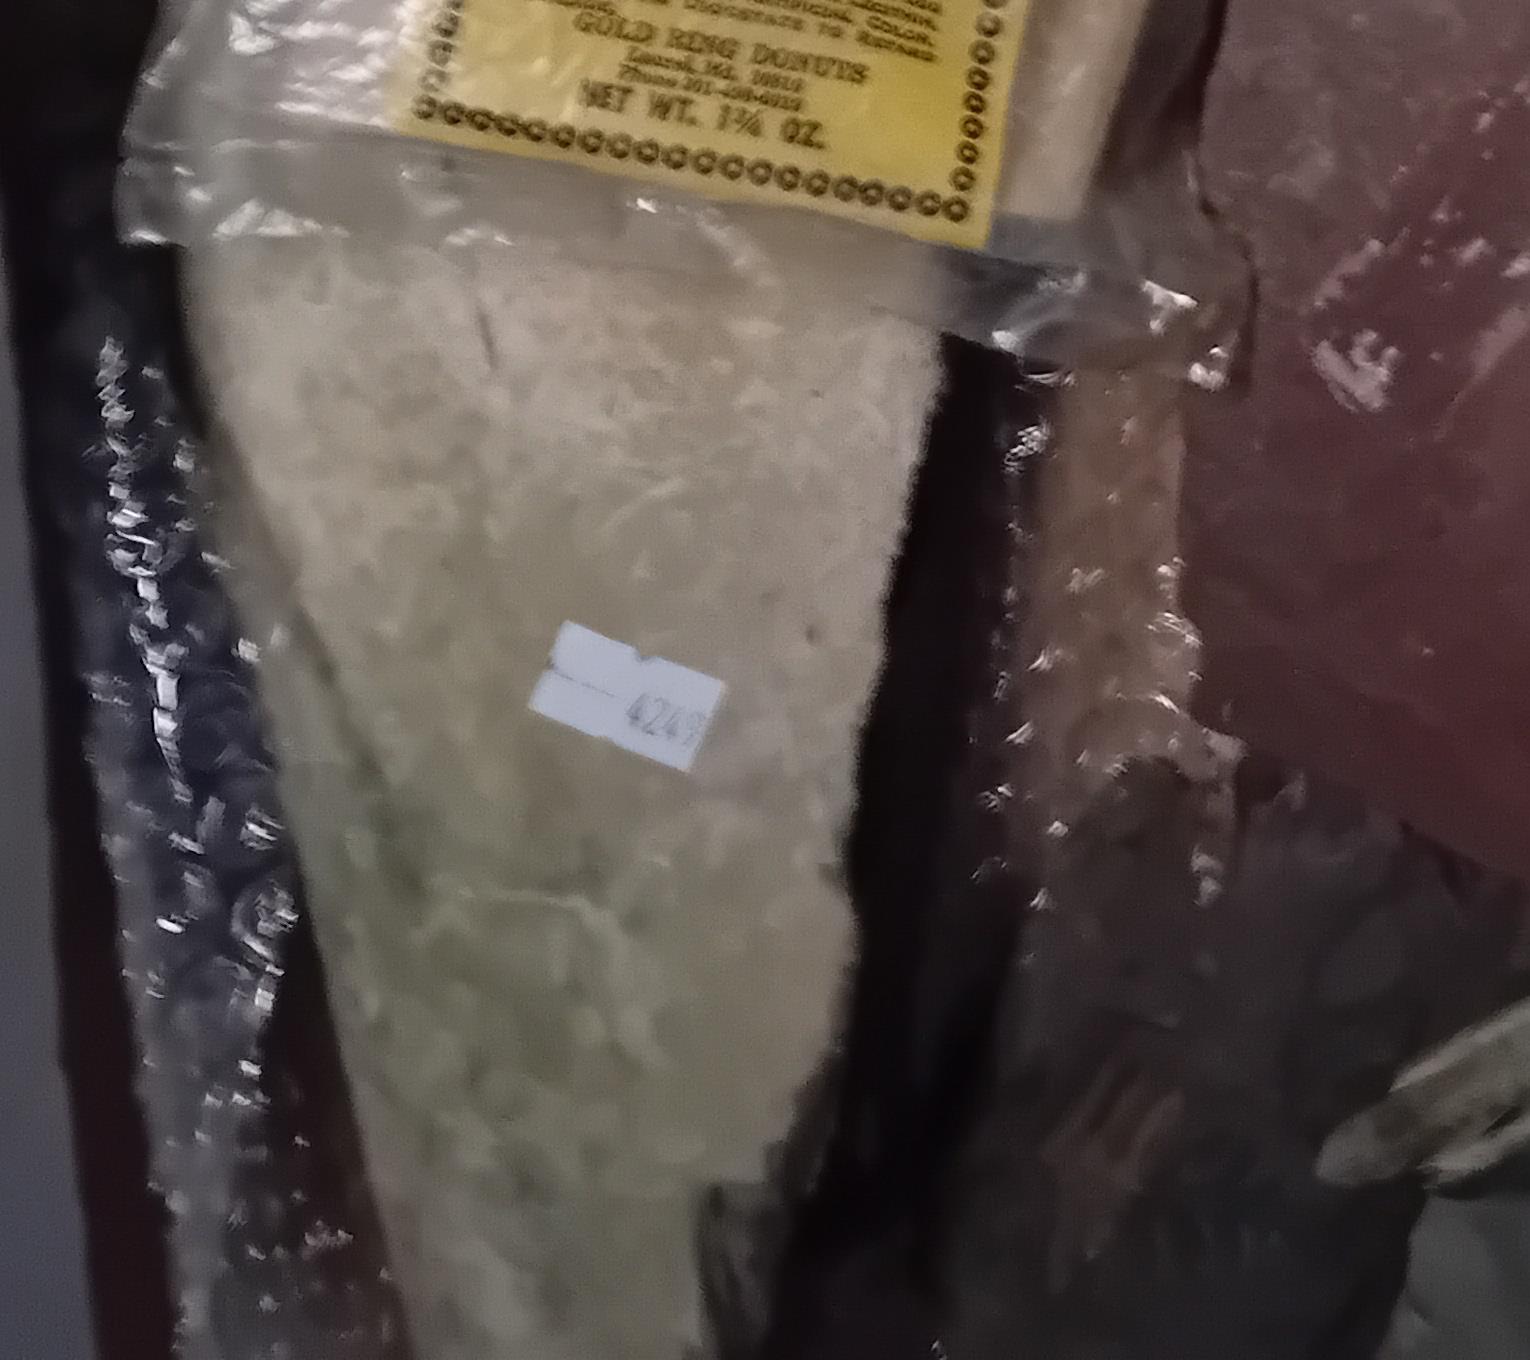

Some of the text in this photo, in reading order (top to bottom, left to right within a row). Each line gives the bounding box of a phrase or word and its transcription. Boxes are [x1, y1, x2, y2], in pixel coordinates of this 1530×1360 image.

[573, 9, 868, 85] GOLD RING DONUTS
[576, 77, 633, 114] NET
[646, 91, 703, 125] WT.
